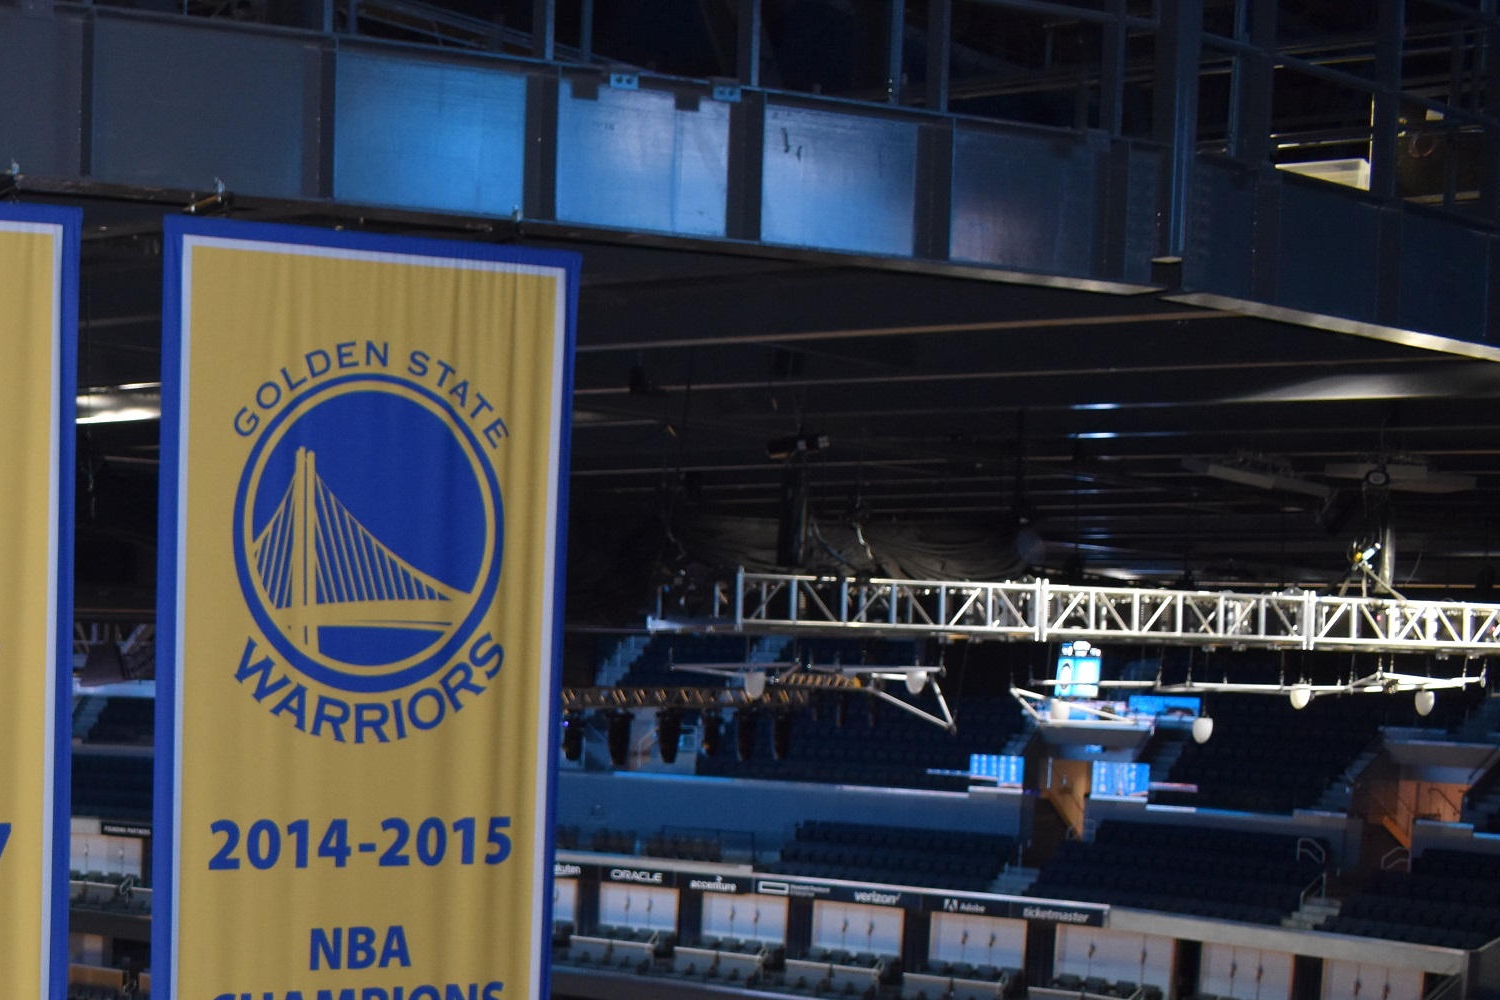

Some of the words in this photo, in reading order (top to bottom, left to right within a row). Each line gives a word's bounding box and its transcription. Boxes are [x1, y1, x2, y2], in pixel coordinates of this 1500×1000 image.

[233, 340, 390, 438] GOLDEN
[407, 349, 510, 450] STATE
[232, 631, 506, 744] WARRIORS
[207, 816, 513, 871] 2014-2015
[610, 868, 663, 884] ORACLE
[689, 877, 737, 892] accenture
[854, 890, 899, 905] verizon
[959, 902, 986, 914] Adobe
[1023, 907, 1090, 923] ticketmaster
[310, 925, 411, 971] NBA
